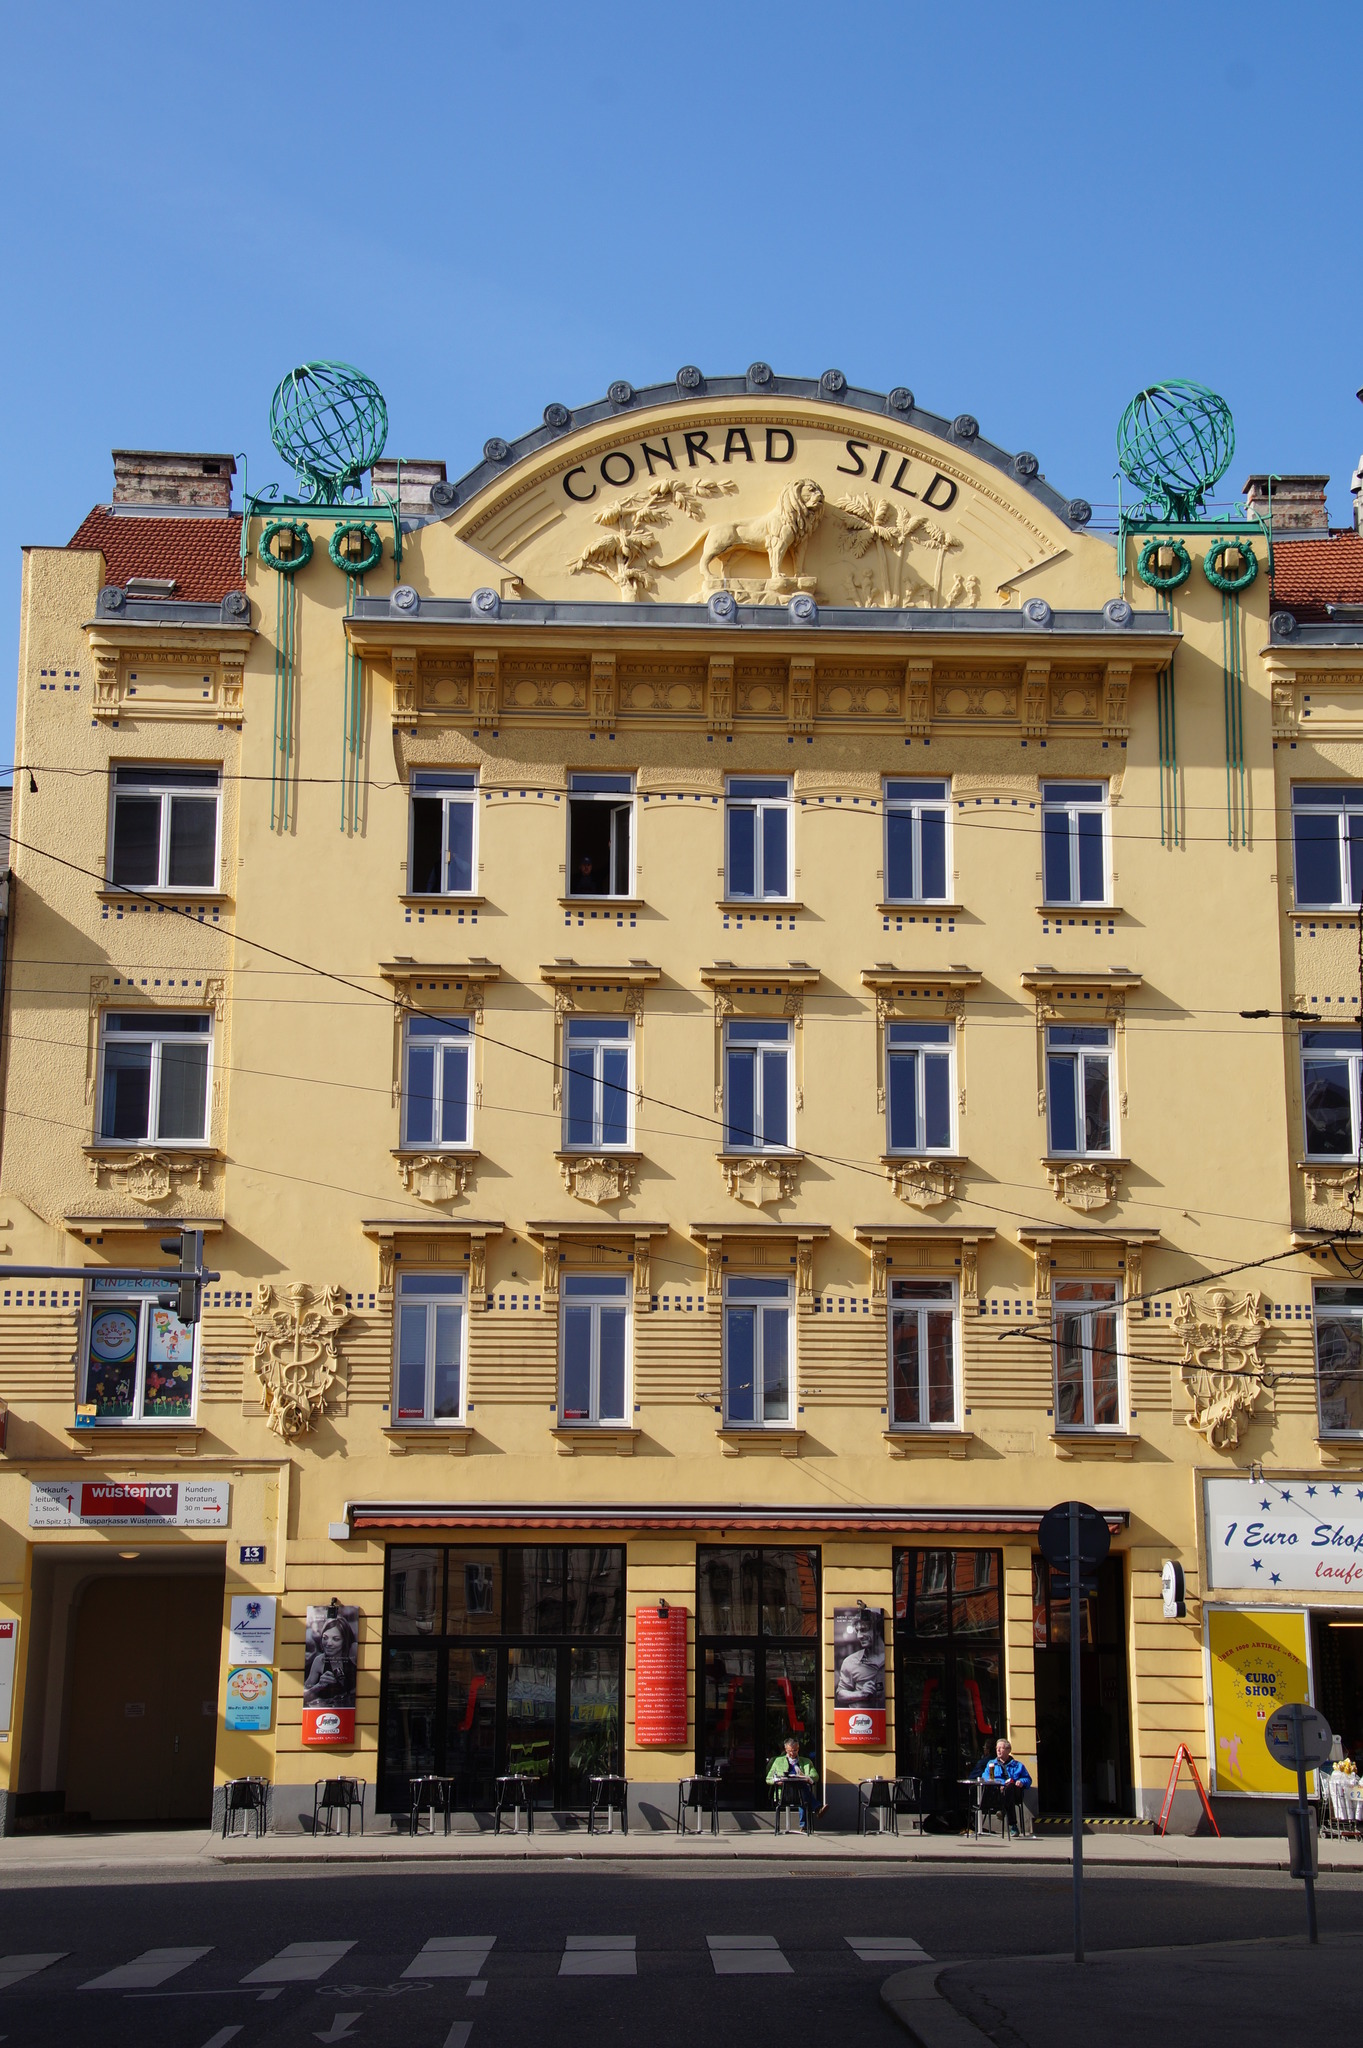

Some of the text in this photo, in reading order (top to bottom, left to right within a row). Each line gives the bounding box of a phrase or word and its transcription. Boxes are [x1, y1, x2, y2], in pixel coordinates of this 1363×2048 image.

[562, 428, 958, 512] CONRAD SILD
[92, 1483, 172, 1498] wüstenrot
[35, 1496, 60, 1504] leitung
[184, 1495, 217, 1503] beratung
[1224, 1522, 1238, 1547] 1
[1243, 1523, 1299, 1547] Euro
[244, 1547, 260, 1557] 13
[1217, 1648, 1234, 1663] ÜBER
[1236, 1643, 1250, 1652] 1000
[1252, 1642, 1281, 1652] ARTIKEL
[1245, 1685, 1277, 1697] SHOP
